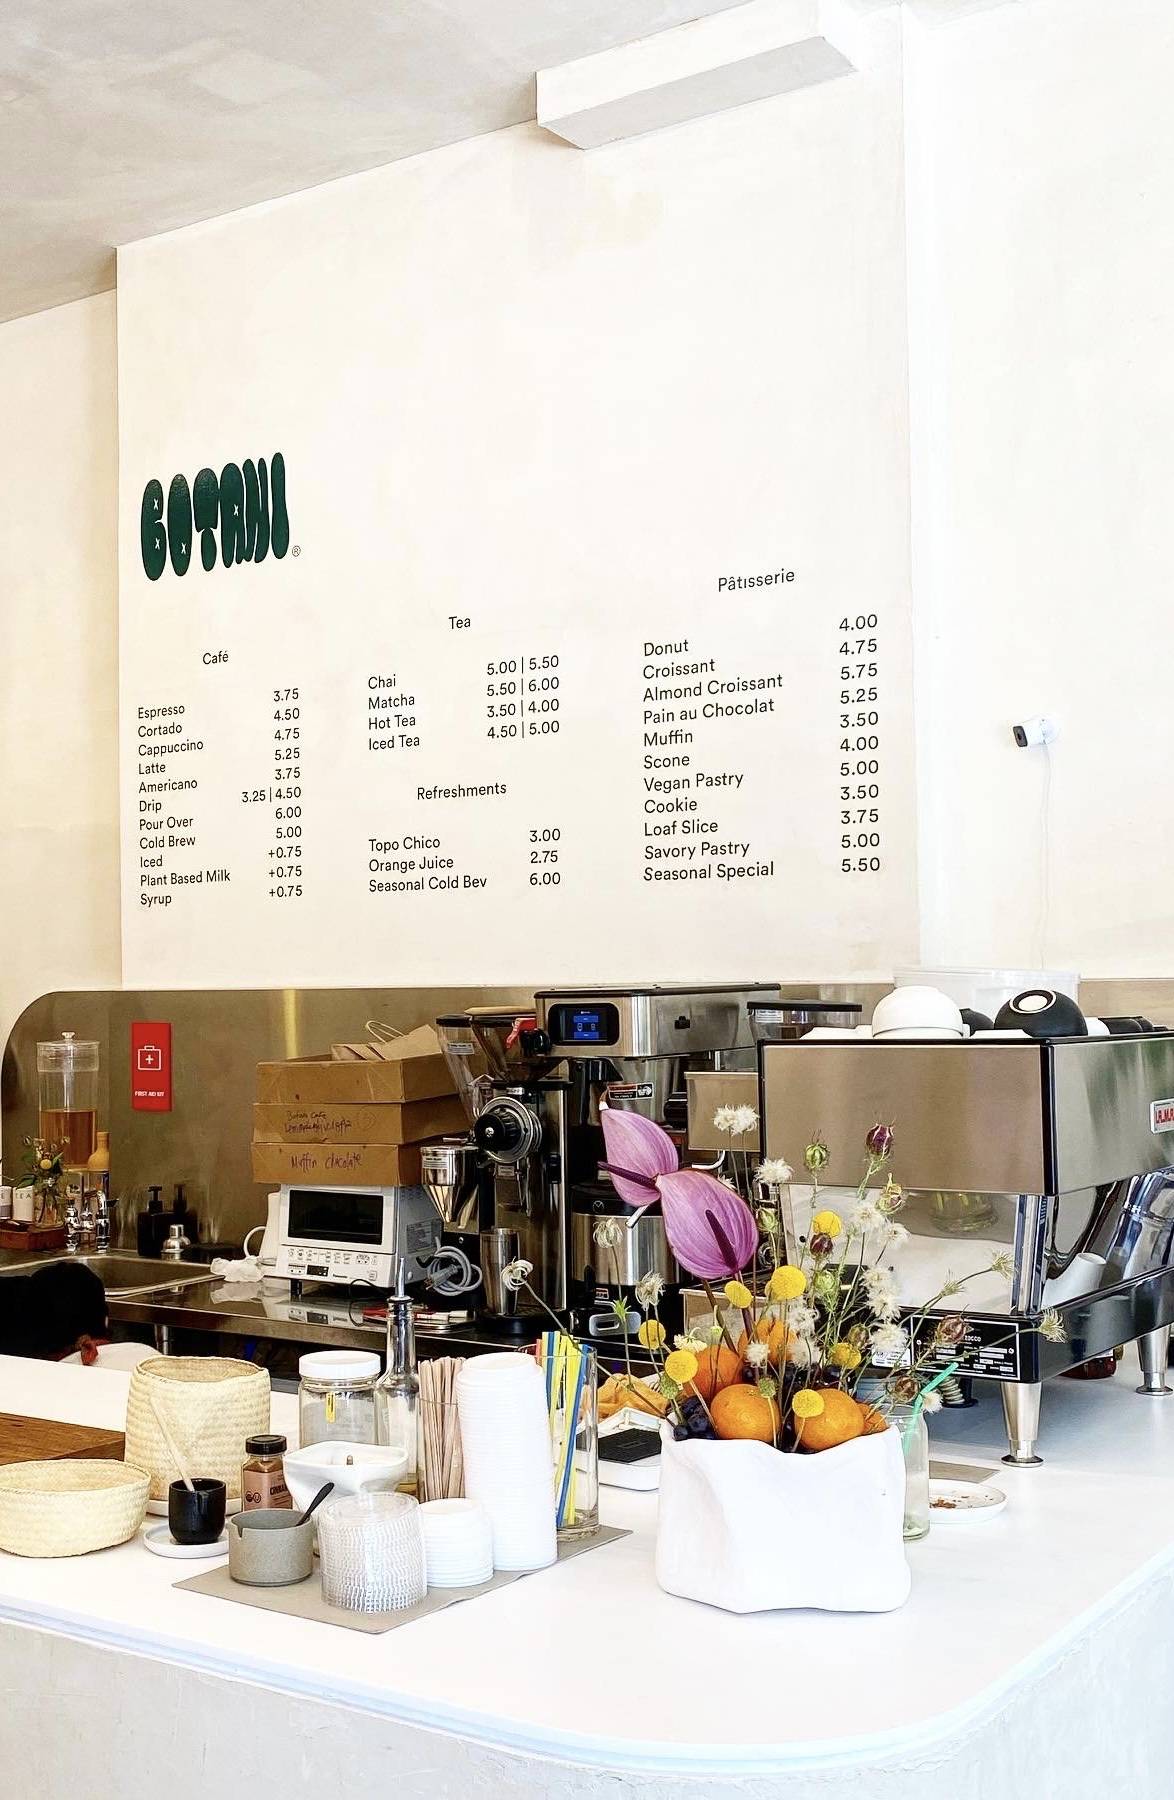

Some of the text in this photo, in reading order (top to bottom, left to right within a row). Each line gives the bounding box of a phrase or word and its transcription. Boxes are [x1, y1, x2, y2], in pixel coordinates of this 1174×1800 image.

[140, 451, 290, 582] BOTANI
[447, 615, 471, 630] Tea
[838, 613, 878, 632] 4.00
[643, 639, 689, 657] Donut
[839, 638, 878, 656] 4.75
[202, 648, 229, 665] Café
[486, 660, 517, 676] 5.00
[528, 654, 560, 671] 5.50
[642, 658, 716, 680] Croissant
[840, 662, 878, 681] 5.75
[367, 673, 396, 690] Chai
[486, 681, 517, 697] 5.50
[528, 676, 560, 693] 6.00
[642, 673, 783, 703] Almond Croissant
[273, 687, 299, 703] 3.75
[368, 693, 415, 711] Matcha
[839, 686, 878, 705] 5.25
[137, 705, 186, 721] Espresso
[273, 707, 300, 722] 4.50
[486, 703, 517, 719] 3.50
[527, 698, 560, 714] 4.00
[643, 697, 775, 725] Pain au Chocolat
[368, 713, 416, 731] Hot Tea
[839, 711, 879, 729] 3.50
[137, 721, 183, 738] Cortado
[274, 727, 300, 741] 4.75
[486, 724, 518, 740] 4.50
[528, 720, 560, 736] 5.00
[643, 728, 693, 748] Muffin
[138, 738, 204, 758] Cappuccino
[368, 734, 420, 751] Iced Tea
[839, 735, 879, 752] 4.00
[274, 746, 301, 761] 5.25
[643, 754, 690, 770] Scone
[138, 762, 166, 775] Latte
[274, 766, 301, 781] 3.75
[839, 759, 879, 777] 5.00
[138, 778, 198, 794] Americano
[417, 782, 507, 801] Refreshments
[643, 772, 744, 794] Vegan Pastry
[241, 789, 266, 803] 3.25
[274, 786, 302, 800] 4.50
[840, 783, 879, 801] 3.50
[139, 798, 162, 814] Drip
[275, 805, 302, 820] 6.00
[643, 796, 698, 814] Cookie
[139, 816, 194, 831] Pour Over
[840, 808, 879, 825] 3.75
[275, 825, 302, 839] 5.00
[529, 828, 561, 843] 3.00
[644, 818, 719, 837] Loaf Slice
[139, 834, 196, 850] Cold Brew
[368, 835, 441, 855] Topo Chico
[841, 832, 880, 849] 5.00
[267, 845, 302, 859] +0.75
[530, 849, 559, 864] 2.75
[644, 841, 751, 861] Savory Pastry
[140, 854, 163, 869] Iced
[368, 855, 454, 874] Orange Juice
[841, 856, 881, 873] 5.50
[140, 868, 231, 887] Plant Based Milk
[268, 864, 303, 879] +0.75
[529, 871, 561, 886] 6.00
[642, 860, 774, 882] Seasonal Special
[268, 884, 303, 898] +0.75
[368, 874, 488, 893] Seasonal Cold Bev
[140, 892, 172, 908] Syrup
